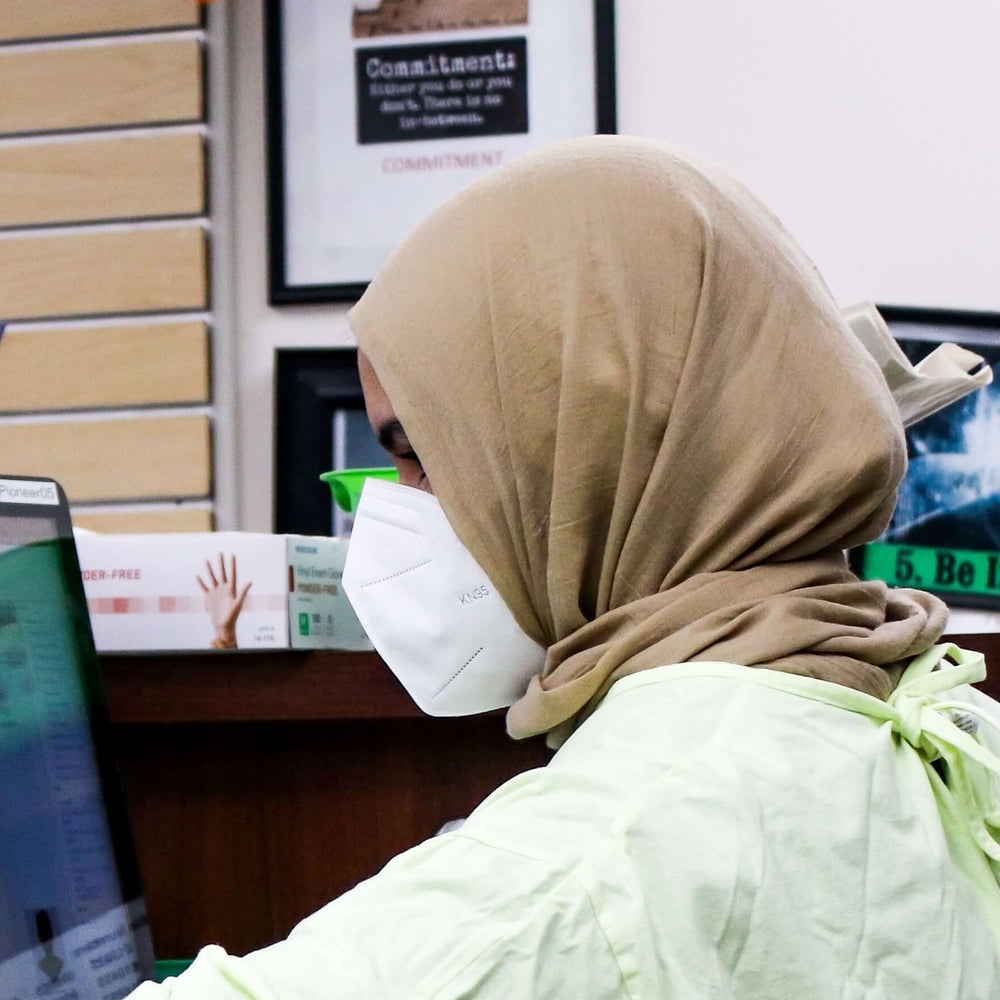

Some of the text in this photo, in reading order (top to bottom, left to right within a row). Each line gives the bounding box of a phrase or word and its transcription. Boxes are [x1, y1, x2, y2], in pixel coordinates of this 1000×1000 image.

[419, 81, 443, 96] you
[447, 78, 463, 91] do
[467, 79, 482, 89] or
[486, 76, 513, 91] you
[381, 151, 503, 174] COMMITMENT
[81, 569, 141, 581] DER-FREE
[895, 549, 922, 584] 5.
[934, 550, 976, 588] Be
[458, 584, 490, 606] KN95
